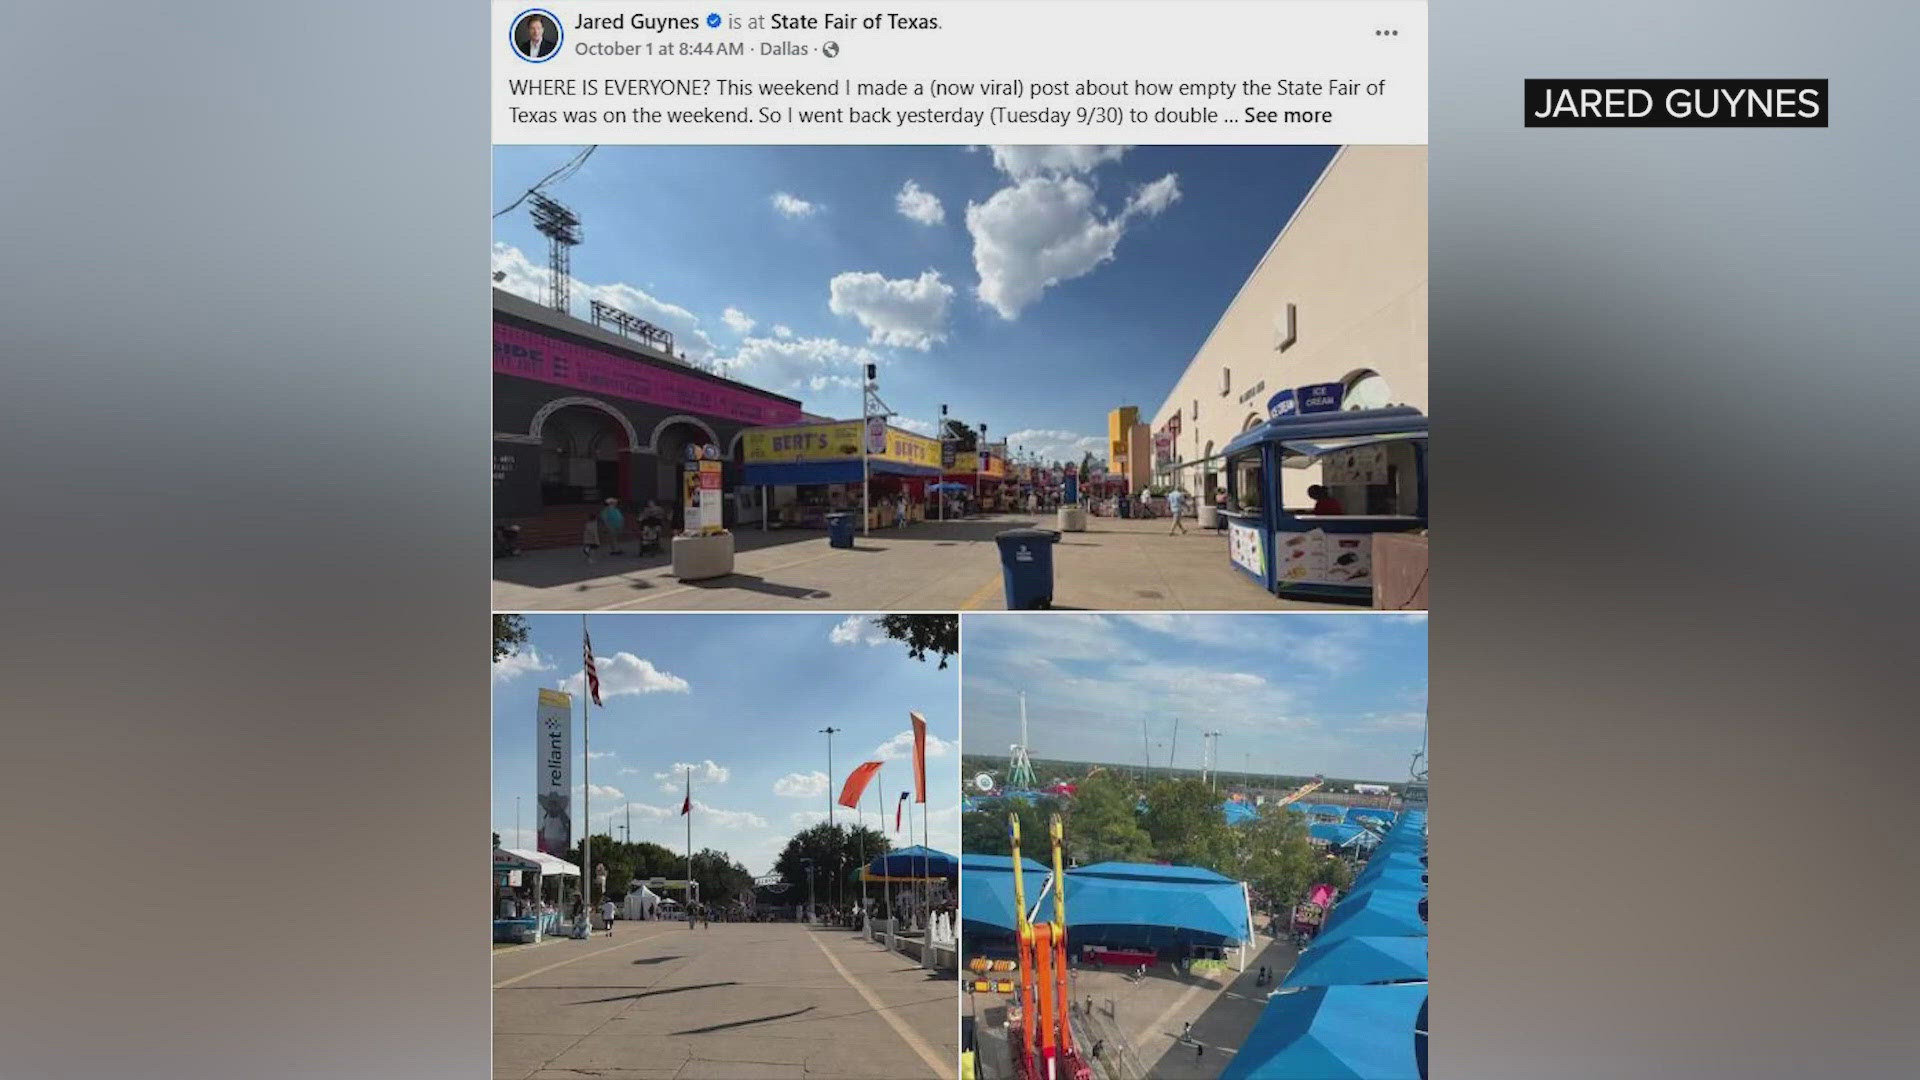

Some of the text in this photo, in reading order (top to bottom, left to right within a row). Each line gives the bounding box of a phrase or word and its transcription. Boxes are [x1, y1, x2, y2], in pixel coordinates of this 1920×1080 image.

[574, 13, 943, 34] Jared Guynes is at State Fair of Texas.
[574, 40, 643, 56] October
[645, 41, 653, 56] 1
[658, 41, 675, 56] at
[760, 40, 809, 56] Dallas
[508, 79, 577, 96] WHERE
[582, 79, 599, 96] IS
[604, 79, 711, 96] EVERYONE?
[715, 79, 753, 96] This
[757, 79, 839, 96] weekend
[857, 79, 909, 96] made
[913, 83, 924, 96] a
[930, 79, 975, 99] (now
[979, 79, 1024, 99] viral)
[1030, 80, 1070, 100] post
[1075, 79, 1129, 96] about
[1134, 79, 1174, 96] how
[1178, 80, 1238, 100] empty
[1241, 79, 1272, 96] the
[1277, 79, 1323, 96] State
[1329, 79, 1361, 96] Fair
[1365, 79, 1387, 96] of
[508, 106, 558, 124] Texas
[562, 110, 598, 124] was
[602, 110, 627, 124] on
[631, 106, 663, 124] the
[666, 106, 753, 124] weekend.
[758, 106, 782, 124] So
[798, 108, 844, 124] went
[849, 106, 892, 124] back
[896, 106, 985, 128] yesterday
[989, 106, 1072, 128] (Tuesday
[1076, 106, 1124, 126] 9/30)
[1128, 107, 1149, 124] to
[1153, 106, 1219, 124] double
[1244, 106, 1279, 124] See
[1283, 110, 1333, 124] more
[1305, 396, 1335, 407] CREAM
[1312, 387, 1327, 396] ICE
[773, 433, 828, 452] BERT'S
[548, 731, 562, 787] reliant
